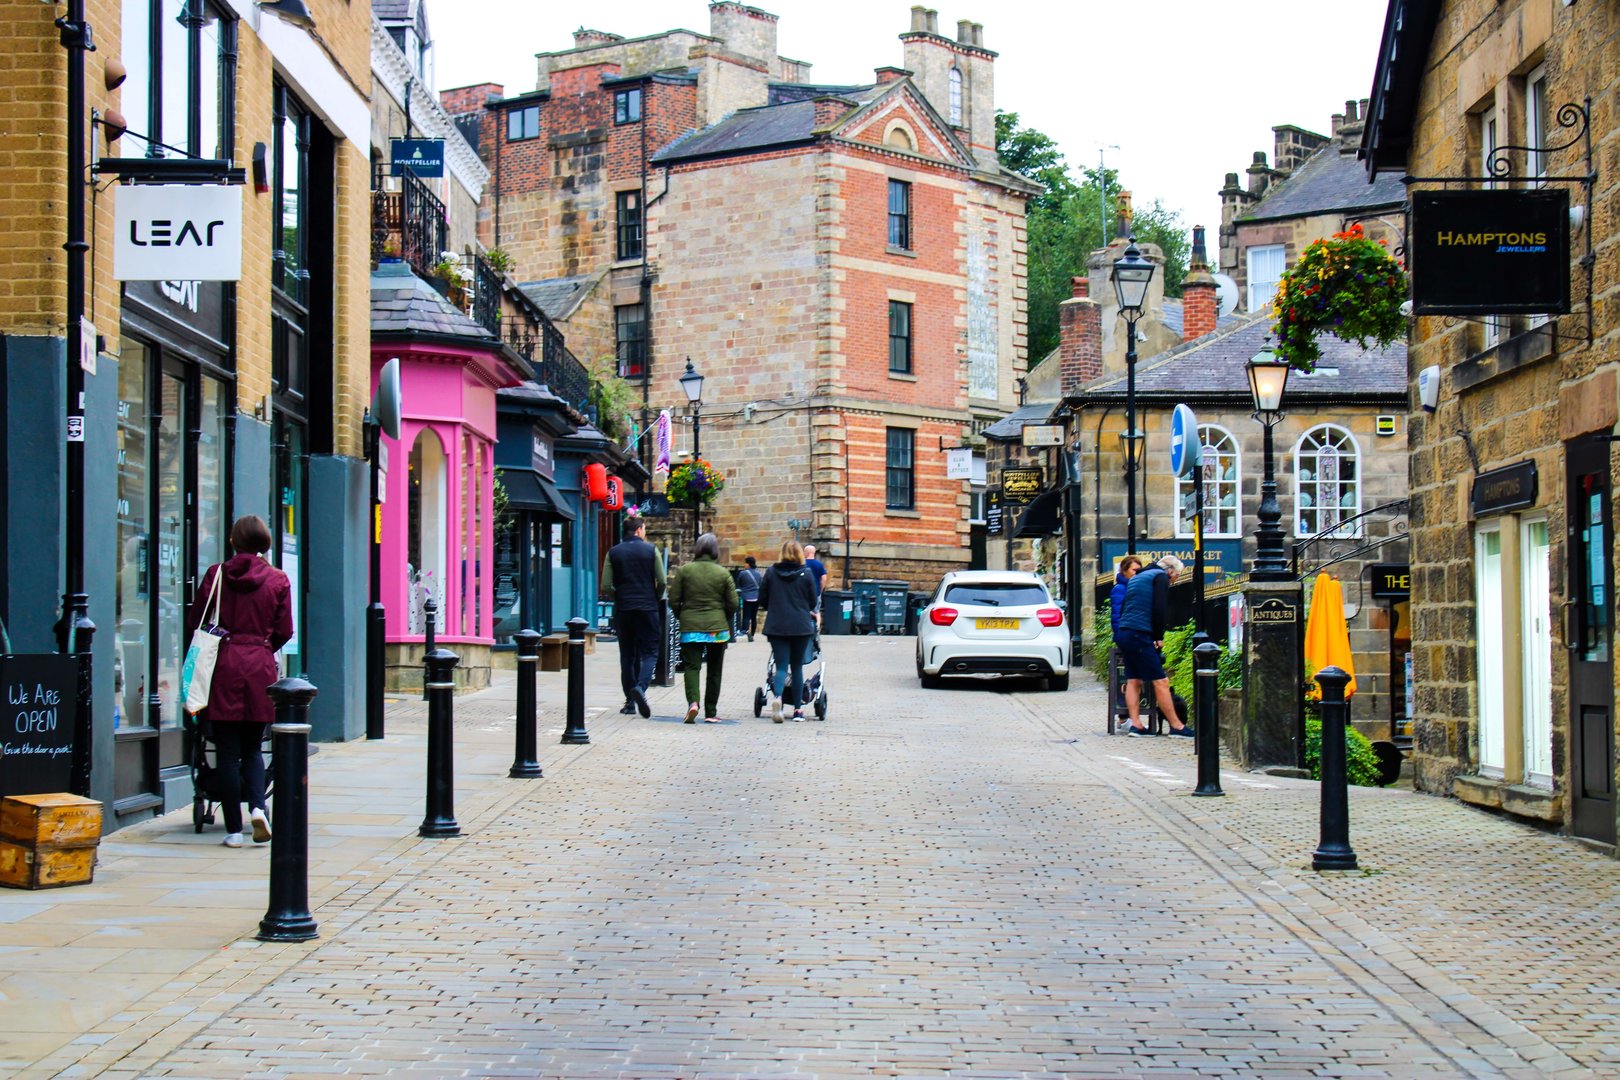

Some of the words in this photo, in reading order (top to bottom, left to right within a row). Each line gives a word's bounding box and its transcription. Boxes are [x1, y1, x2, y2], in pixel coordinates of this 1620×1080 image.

[1437, 231, 1547, 246] HAMPTONS
[1174, 550, 1222, 560] MAKET
[1384, 574, 1410, 588] THE
[1254, 611, 1293, 620] ANTIQUES
[34, 683, 61, 705] ARE
[15, 707, 57, 733] OPEN
[22, 742, 34, 755] the
[34, 744, 48, 754] door
